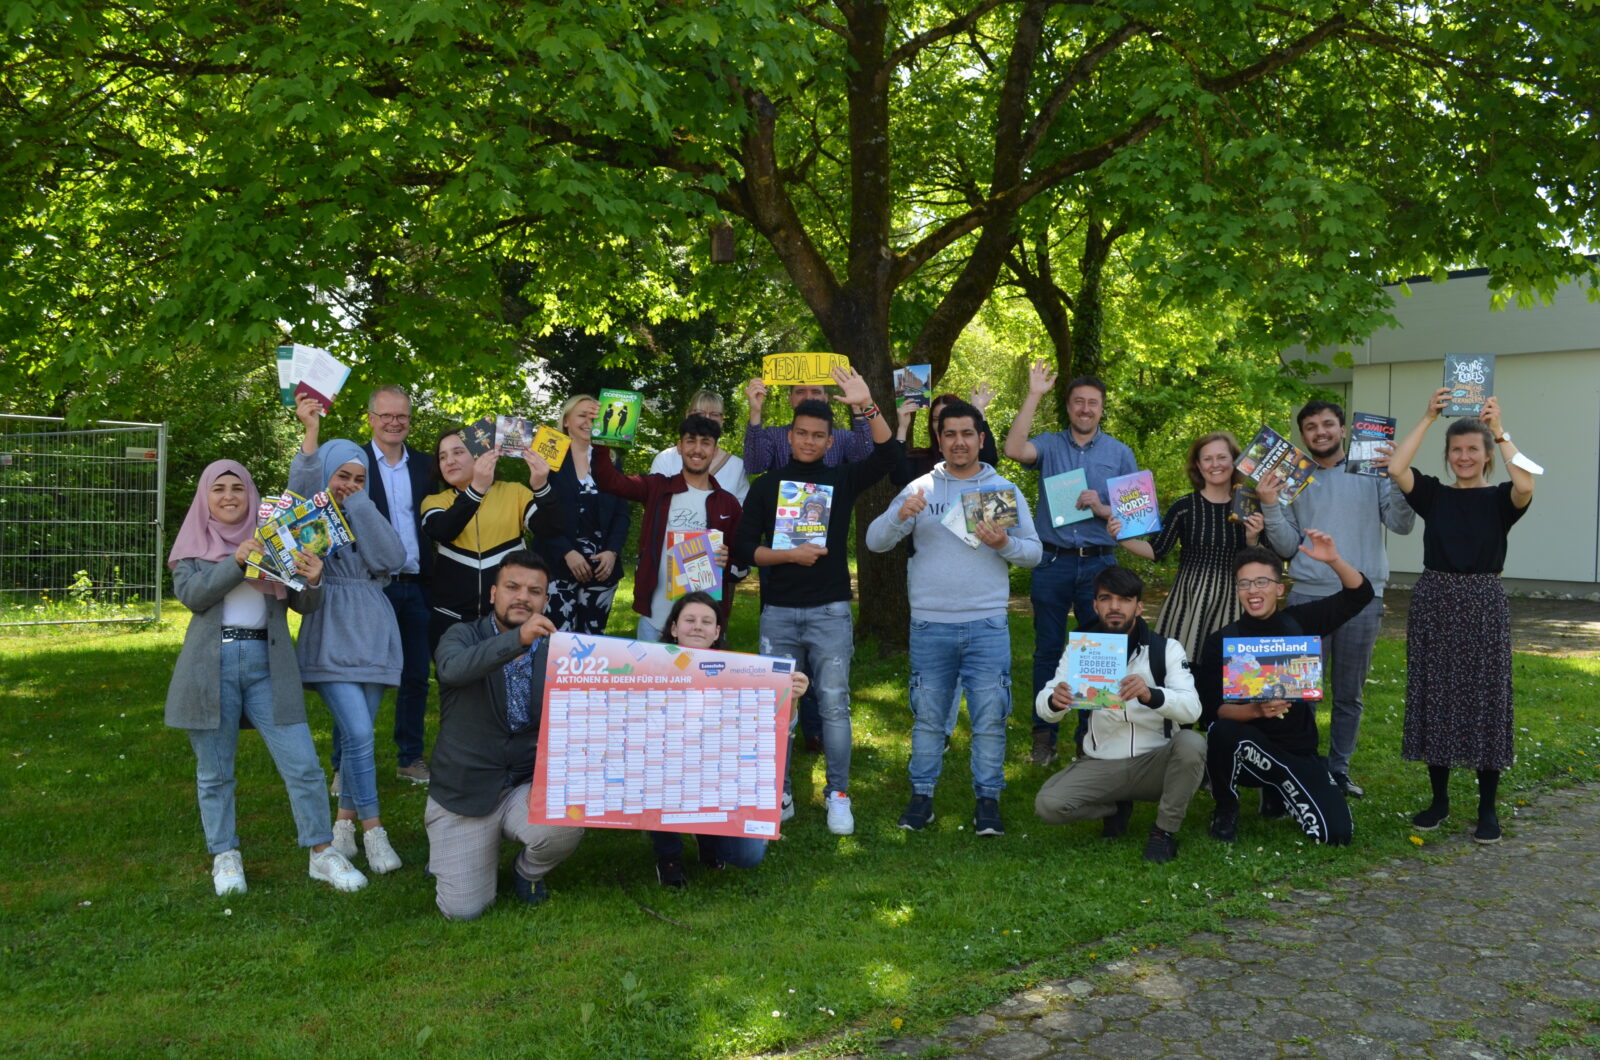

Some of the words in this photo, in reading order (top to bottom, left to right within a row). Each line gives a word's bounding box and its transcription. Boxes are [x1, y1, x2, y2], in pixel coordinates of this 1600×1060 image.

[1453, 359, 1483, 374] YOUNG
[1458, 369, 1485, 384] REBELS
[1355, 421, 1394, 435] COMICS
[1116, 494, 1151, 514] WORDZ
[796, 525, 826, 533] sagen
[1237, 641, 1308, 653] Deutschland
[556, 656, 609, 675] 2022
[1079, 660, 1120, 668] ERDBEER-
[1079, 667, 1117, 675] JOGHURT
[556, 675, 601, 684] AKTIONEN
[602, 675, 609, 684] &
[611, 675, 634, 683] IDEEN
[637, 673, 652, 683] FÜR
[654, 675, 668, 683] EIN
[670, 675, 692, 683] JAHR
[1281, 780, 1320, 837] BLACK
